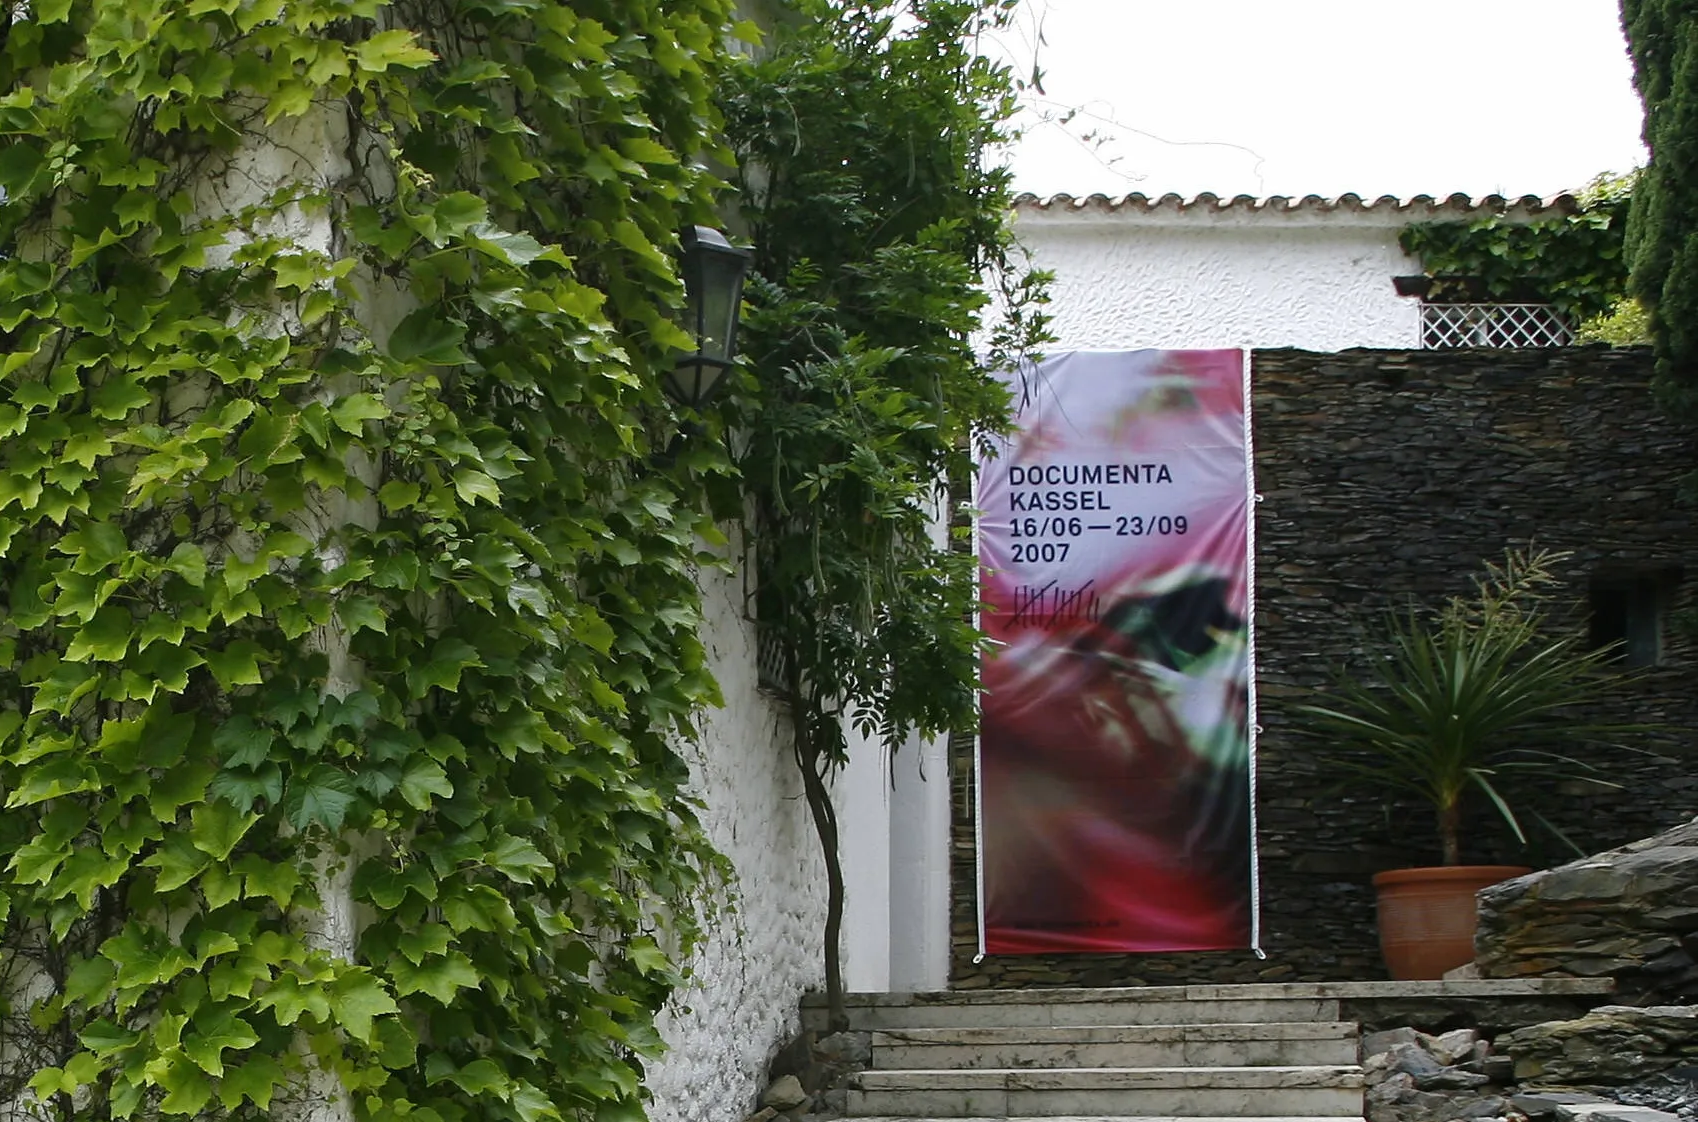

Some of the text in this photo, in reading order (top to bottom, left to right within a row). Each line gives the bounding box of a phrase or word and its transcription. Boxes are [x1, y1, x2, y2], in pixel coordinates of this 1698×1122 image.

[1009, 464, 1172, 486] DOCUMENTA
[1010, 491, 1111, 511] KASSEL
[1011, 543, 1070, 563] 2007
